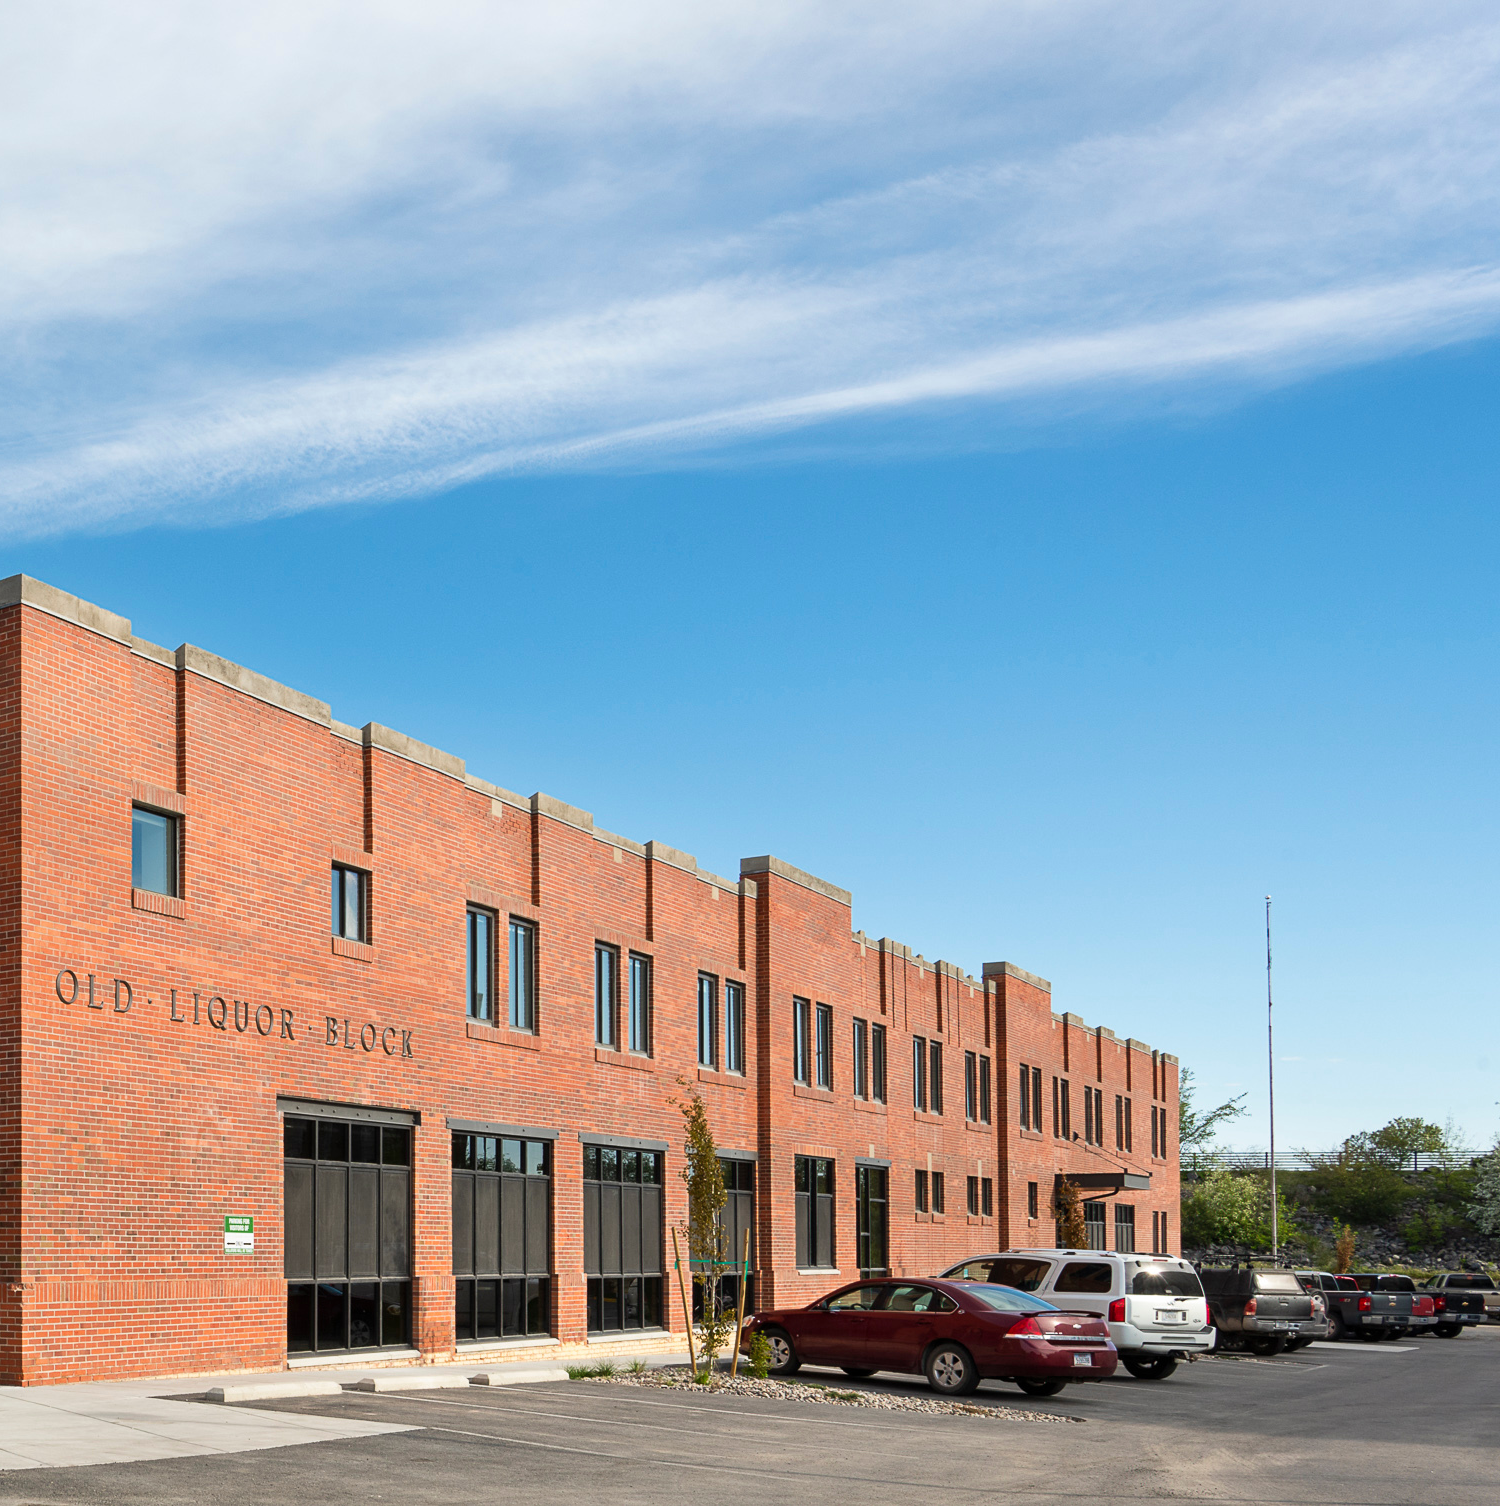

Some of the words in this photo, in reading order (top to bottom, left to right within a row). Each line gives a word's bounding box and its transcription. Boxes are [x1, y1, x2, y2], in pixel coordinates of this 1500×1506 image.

[56, 969, 133, 1013] OLD
[170, 988, 296, 1041] LIQUOR
[325, 1016, 414, 1059] BLOCK
